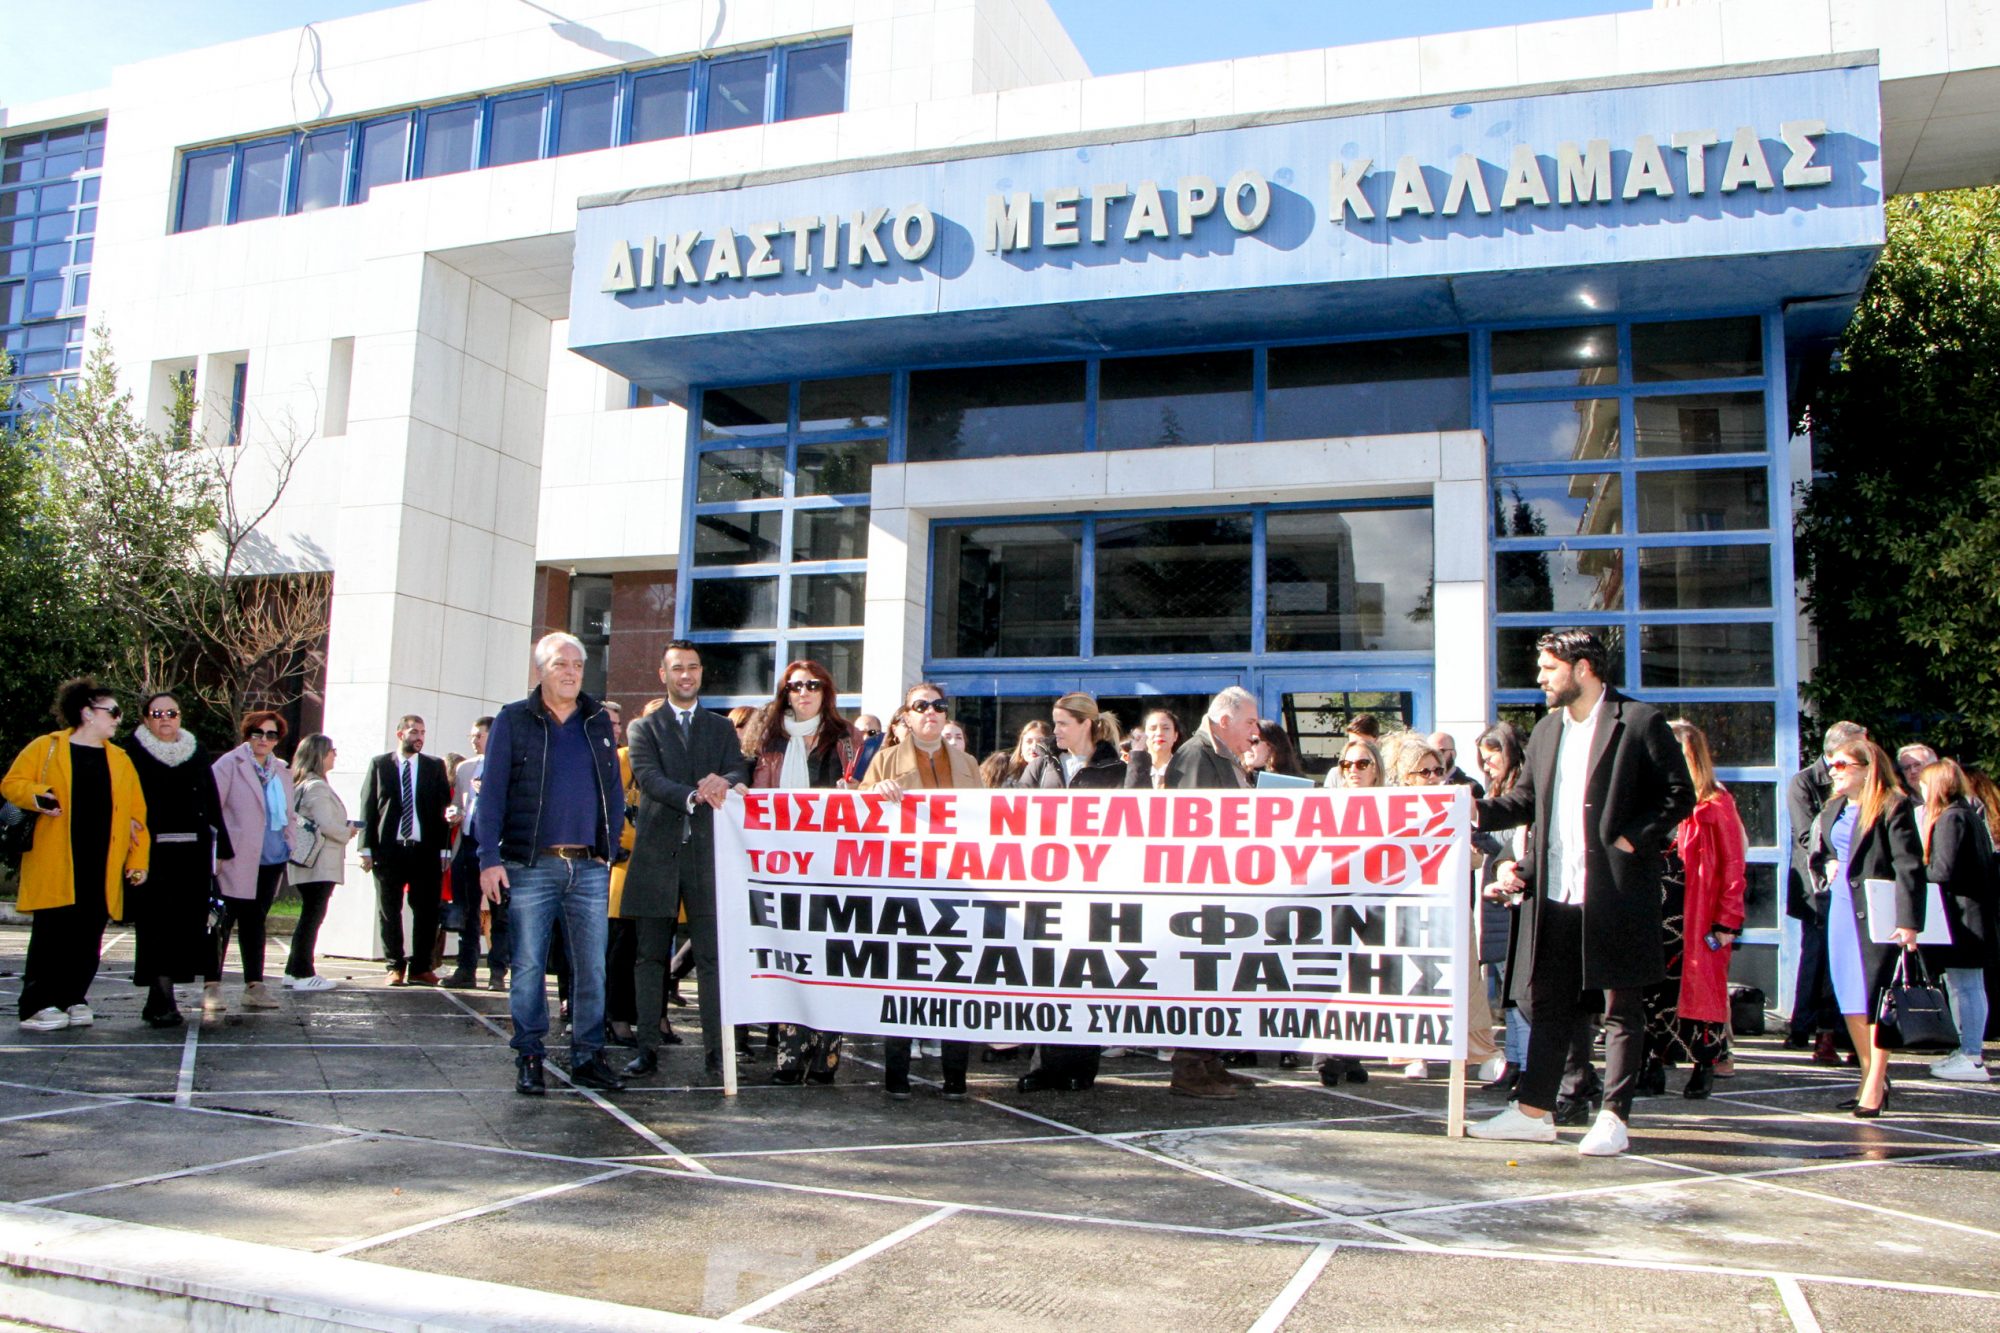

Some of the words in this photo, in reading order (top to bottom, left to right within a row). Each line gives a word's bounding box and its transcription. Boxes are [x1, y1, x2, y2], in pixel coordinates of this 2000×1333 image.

[601, 203, 937, 294] ΔΙΚΑΣΤΙΚΟ
[985, 169, 1271, 252] ΜΕΓΑΡΟ
[1329, 119, 1832, 223] ΚΑΛΑΜΑΤΑΣ
[743, 793, 957, 834] ΕΙΣΑΣΤΕ
[989, 794, 1455, 838] ΝΤΕΛΙΒΕΡΑΔΕΣ
[746, 849, 814, 875] ΤΟΥ
[833, 839, 1112, 882] ΜΕΓΑΛΟΥ
[1143, 844, 1452, 886] ΠΛΟΥΤΟΥ
[748, 889, 1062, 941] ΕΙΜΑΣΤΕ
[1088, 902, 1143, 943] Η
[1169, 904, 1453, 949] ΦΩΝΗ
[749, 948, 812, 975] ΤΗΣ
[825, 938, 1158, 990] ΜΕΣΑΙΑΣ
[1180, 951, 1453, 997] ΤΑΞΗΣ
[880, 994, 1072, 1033] ΔΙΚΗΓΟΡΙΚΟΣ
[1087, 1004, 1242, 1037] ΣΥΛΛΟΓΟΣ
[1258, 1007, 1453, 1046] ΚΑΛΑΜΑΤΑΣ
